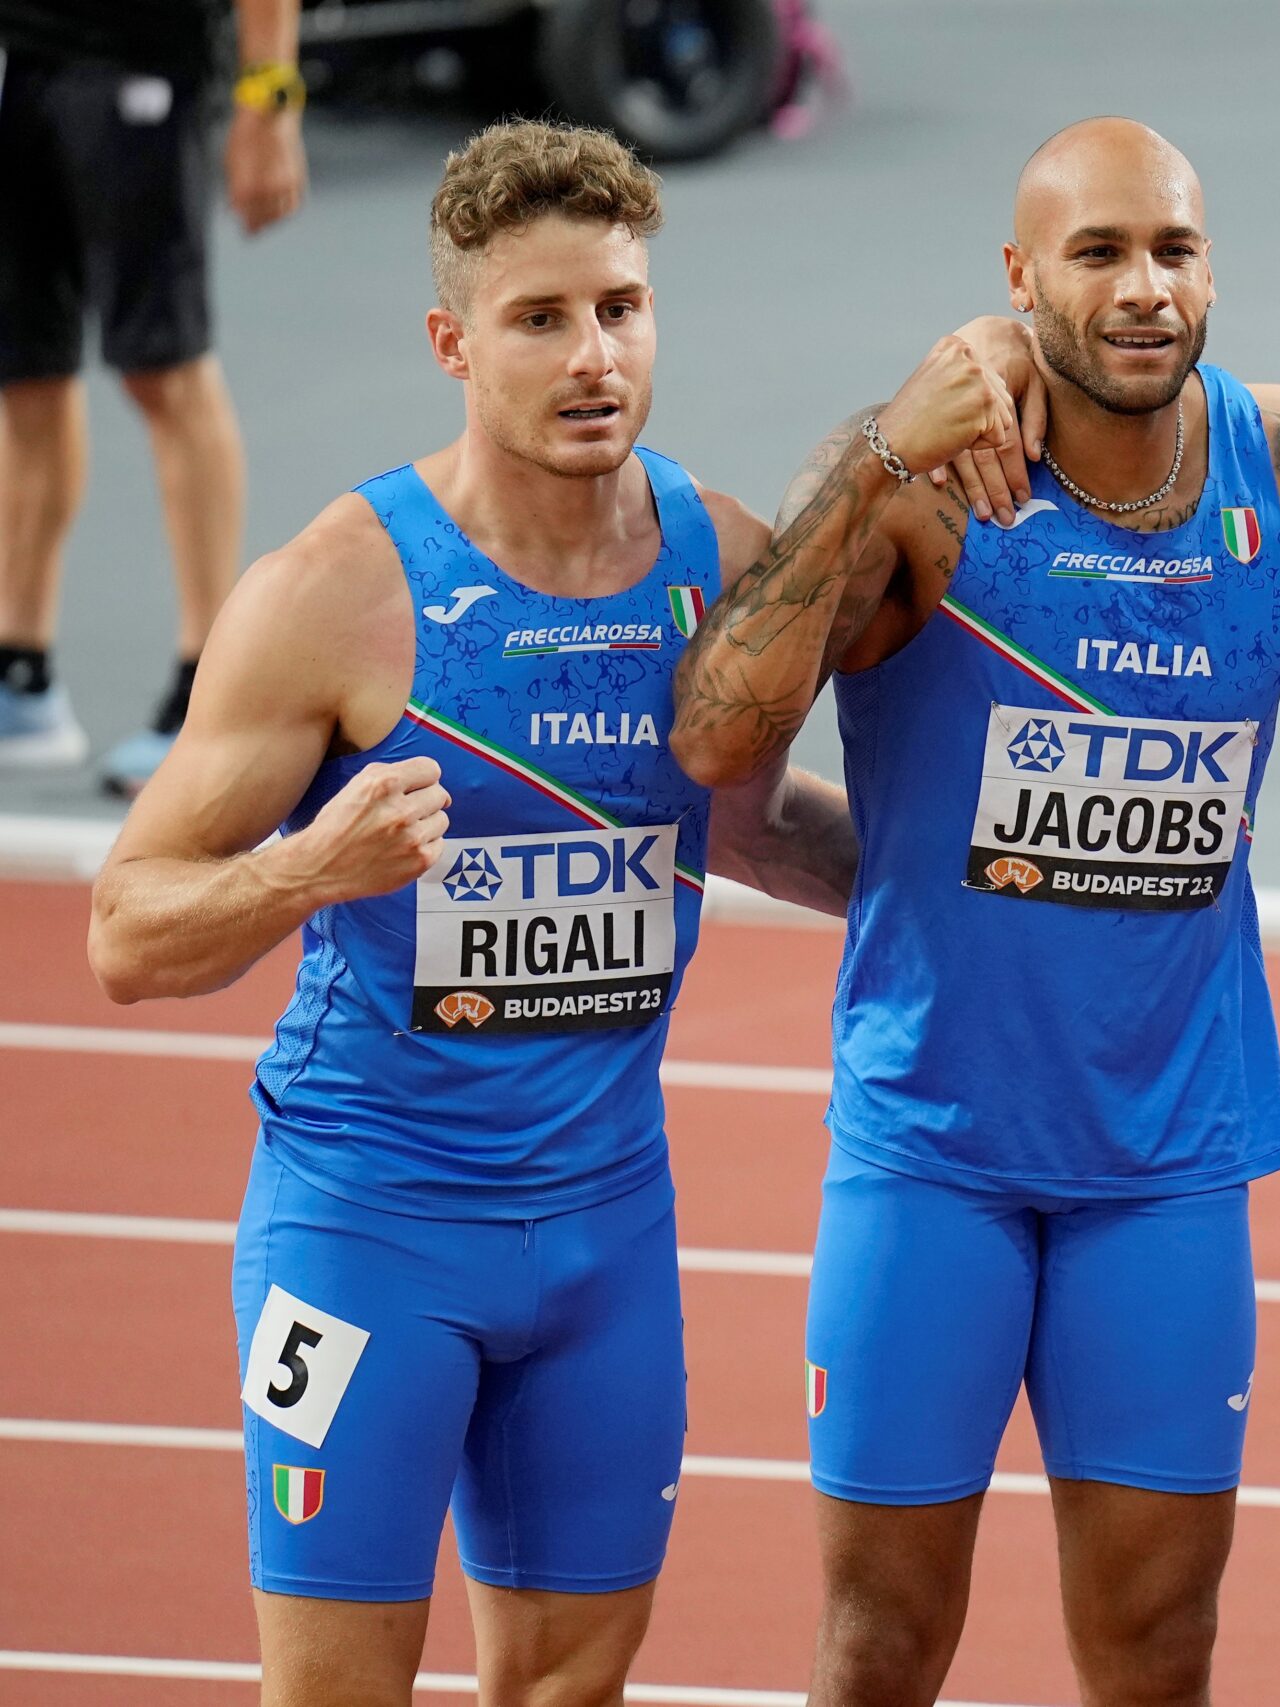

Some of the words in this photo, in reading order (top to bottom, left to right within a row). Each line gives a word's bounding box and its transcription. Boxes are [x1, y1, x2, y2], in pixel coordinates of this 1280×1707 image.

[1051, 552, 1213, 576] FRECCIAROSSA
[503, 623, 663, 647] FRECCIAROSSA
[1075, 637, 1213, 677] ITALIA
[529, 711, 660, 746] ITALIA
[1067, 721, 1239, 784] TDK
[992, 787, 1227, 856] JACOBS
[501, 834, 660, 899] TDK
[1051, 870, 1189, 897] BUDAPEST
[1189, 875, 1213, 897] 23
[459, 908, 645, 978] RIGALI
[503, 990, 638, 1019] BUDAPEST
[639, 987, 662, 1009] 23
[266, 1320, 323, 1409] 5
